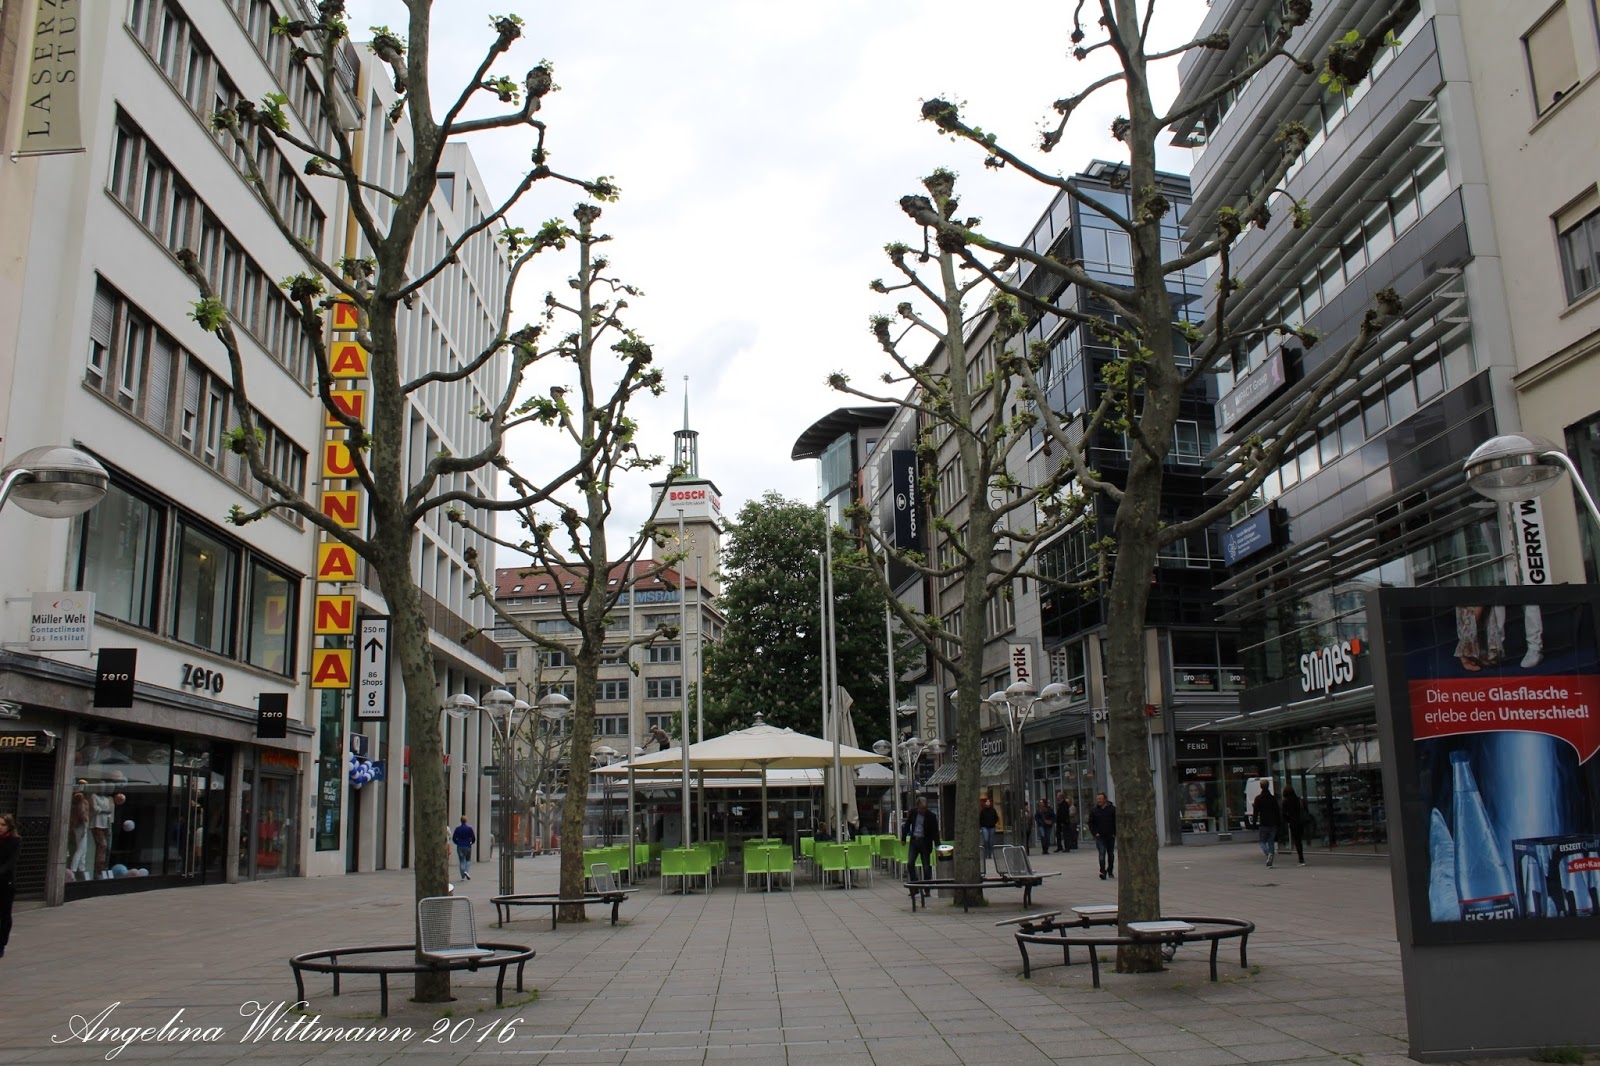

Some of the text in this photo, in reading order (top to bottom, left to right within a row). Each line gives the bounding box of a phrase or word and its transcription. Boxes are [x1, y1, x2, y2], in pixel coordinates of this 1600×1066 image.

[670, 490, 705, 501] BOSCH
[1523, 519, 1546, 585] GERRY
[31, 614, 86, 624] Müller Welt
[30, 634, 46, 642] Das
[1300, 641, 1354, 694] snipes
[102, 672, 129, 682] zero
[182, 663, 224, 694] zero
[361, 679, 383, 687] Shops
[1426, 689, 1449, 703] Die
[1452, 691, 1486, 702] neue
[1488, 686, 1568, 701] Glasflasche
[262, 710, 283, 718] zero
[1425, 704, 1589, 723] erlebe den Unterschied!
[1560, 842, 1581, 852] EISZEIT
